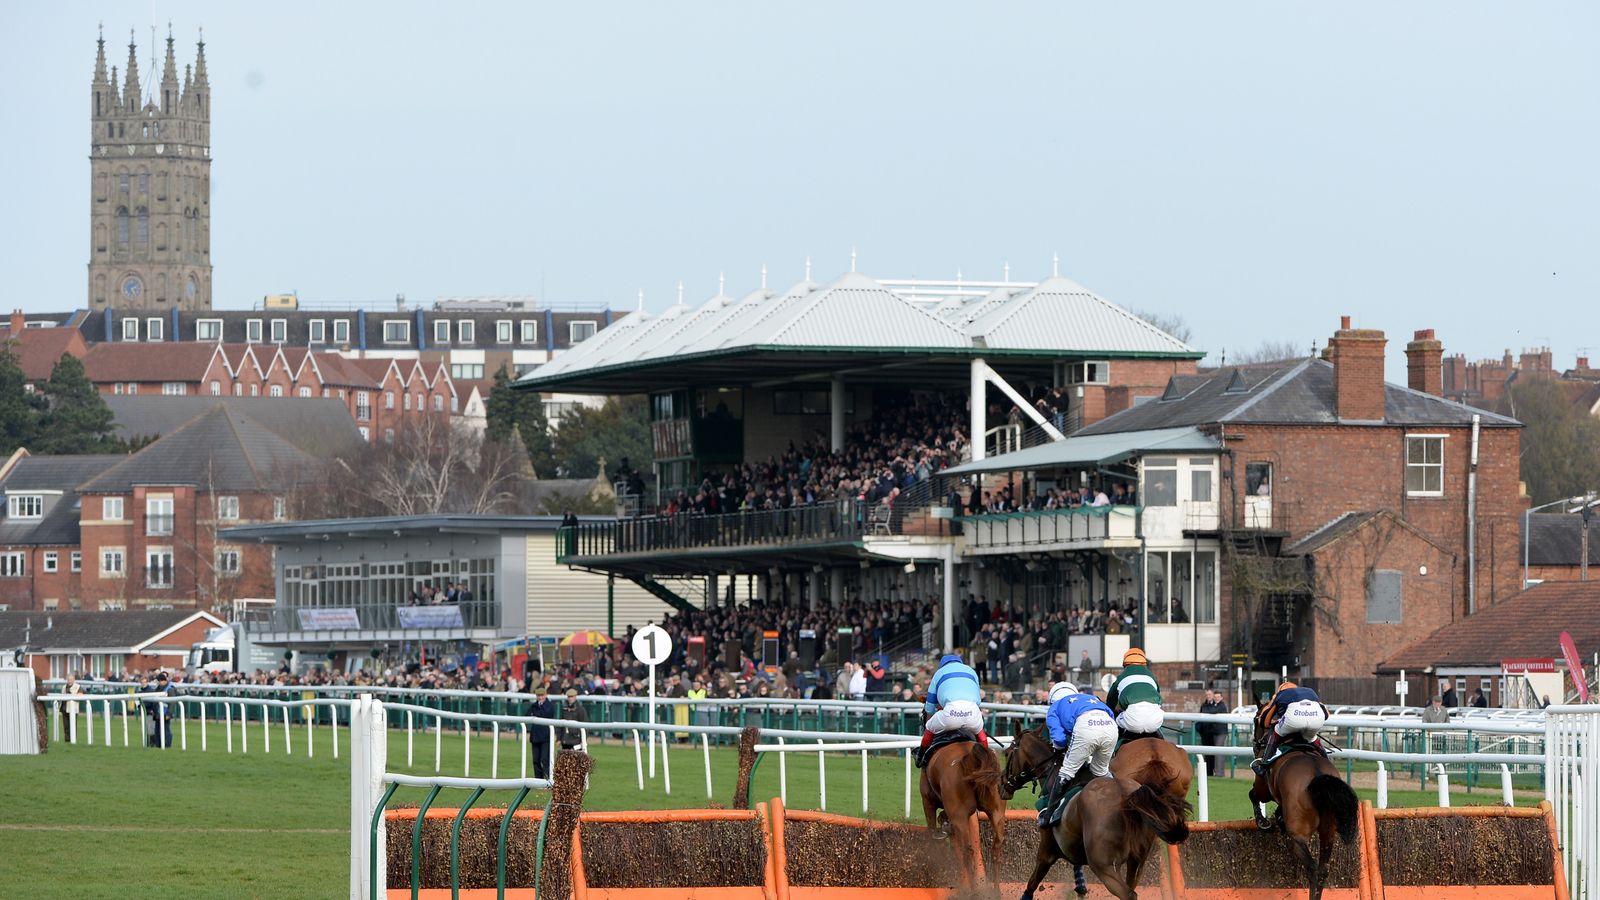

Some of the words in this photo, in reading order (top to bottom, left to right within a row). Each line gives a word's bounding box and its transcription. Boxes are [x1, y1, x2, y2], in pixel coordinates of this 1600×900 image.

[643, 631, 656, 659] 1
[950, 709, 972, 717] Stobart
[1294, 709, 1318, 717] Stobart
